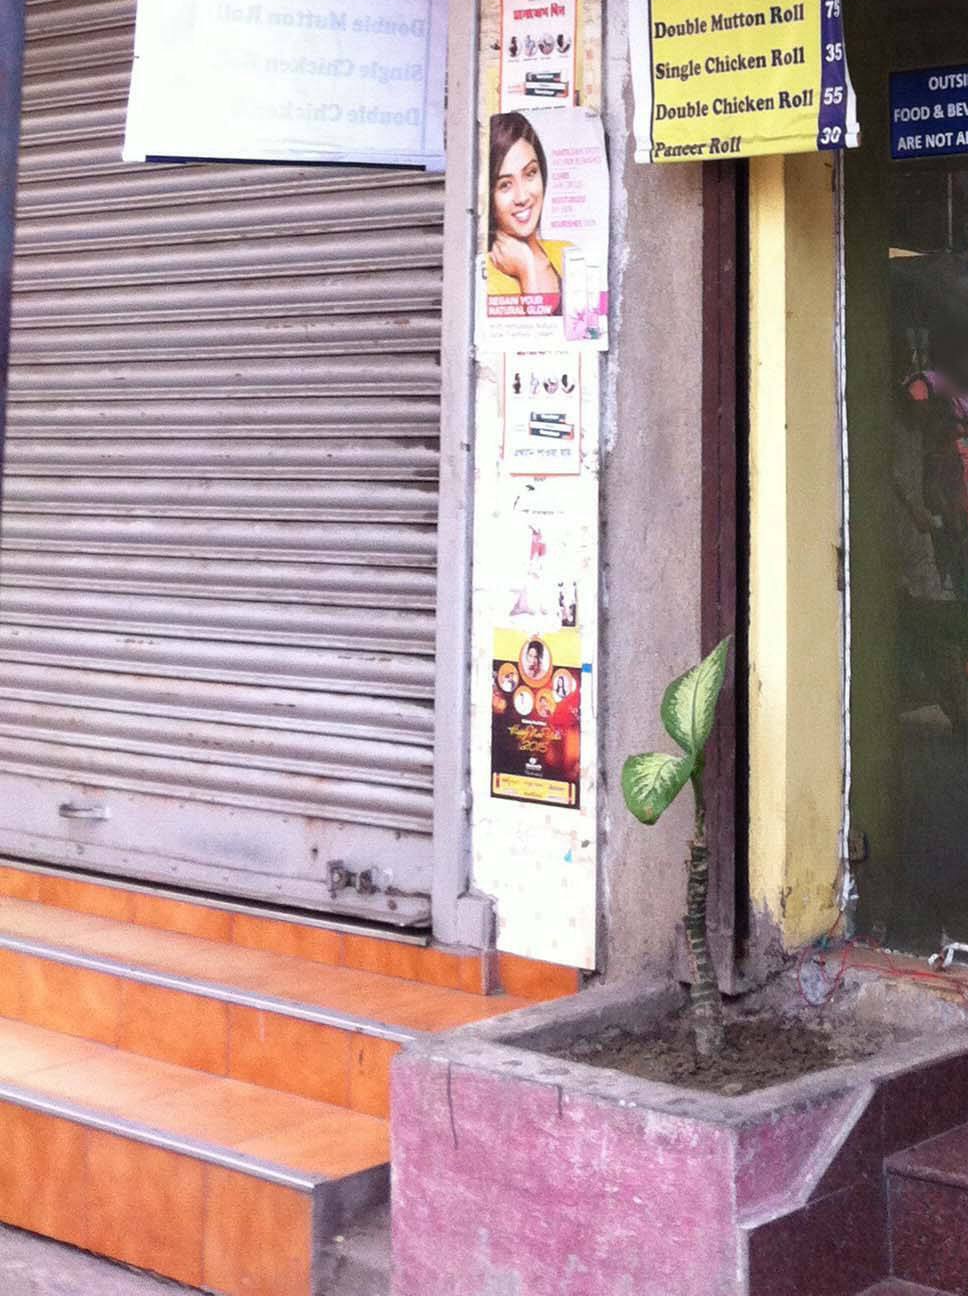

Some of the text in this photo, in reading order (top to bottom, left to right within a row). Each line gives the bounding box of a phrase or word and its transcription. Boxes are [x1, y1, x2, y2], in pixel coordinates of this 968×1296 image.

[654, 15, 707, 40] Double
[710, 6, 766, 32] Mutton
[770, 3, 805, 25] Roll
[654, 43, 843, 82] Single Chicken Roll 35
[655, 85, 843, 121] Double Chicken Roll 55
[893, 103, 931, 123] FOOD
[933, 102, 945, 119] &
[654, 126, 842, 158] Paneer Roll 30
[897, 134, 923, 152] ARE
[925, 132, 953, 149] NOT
